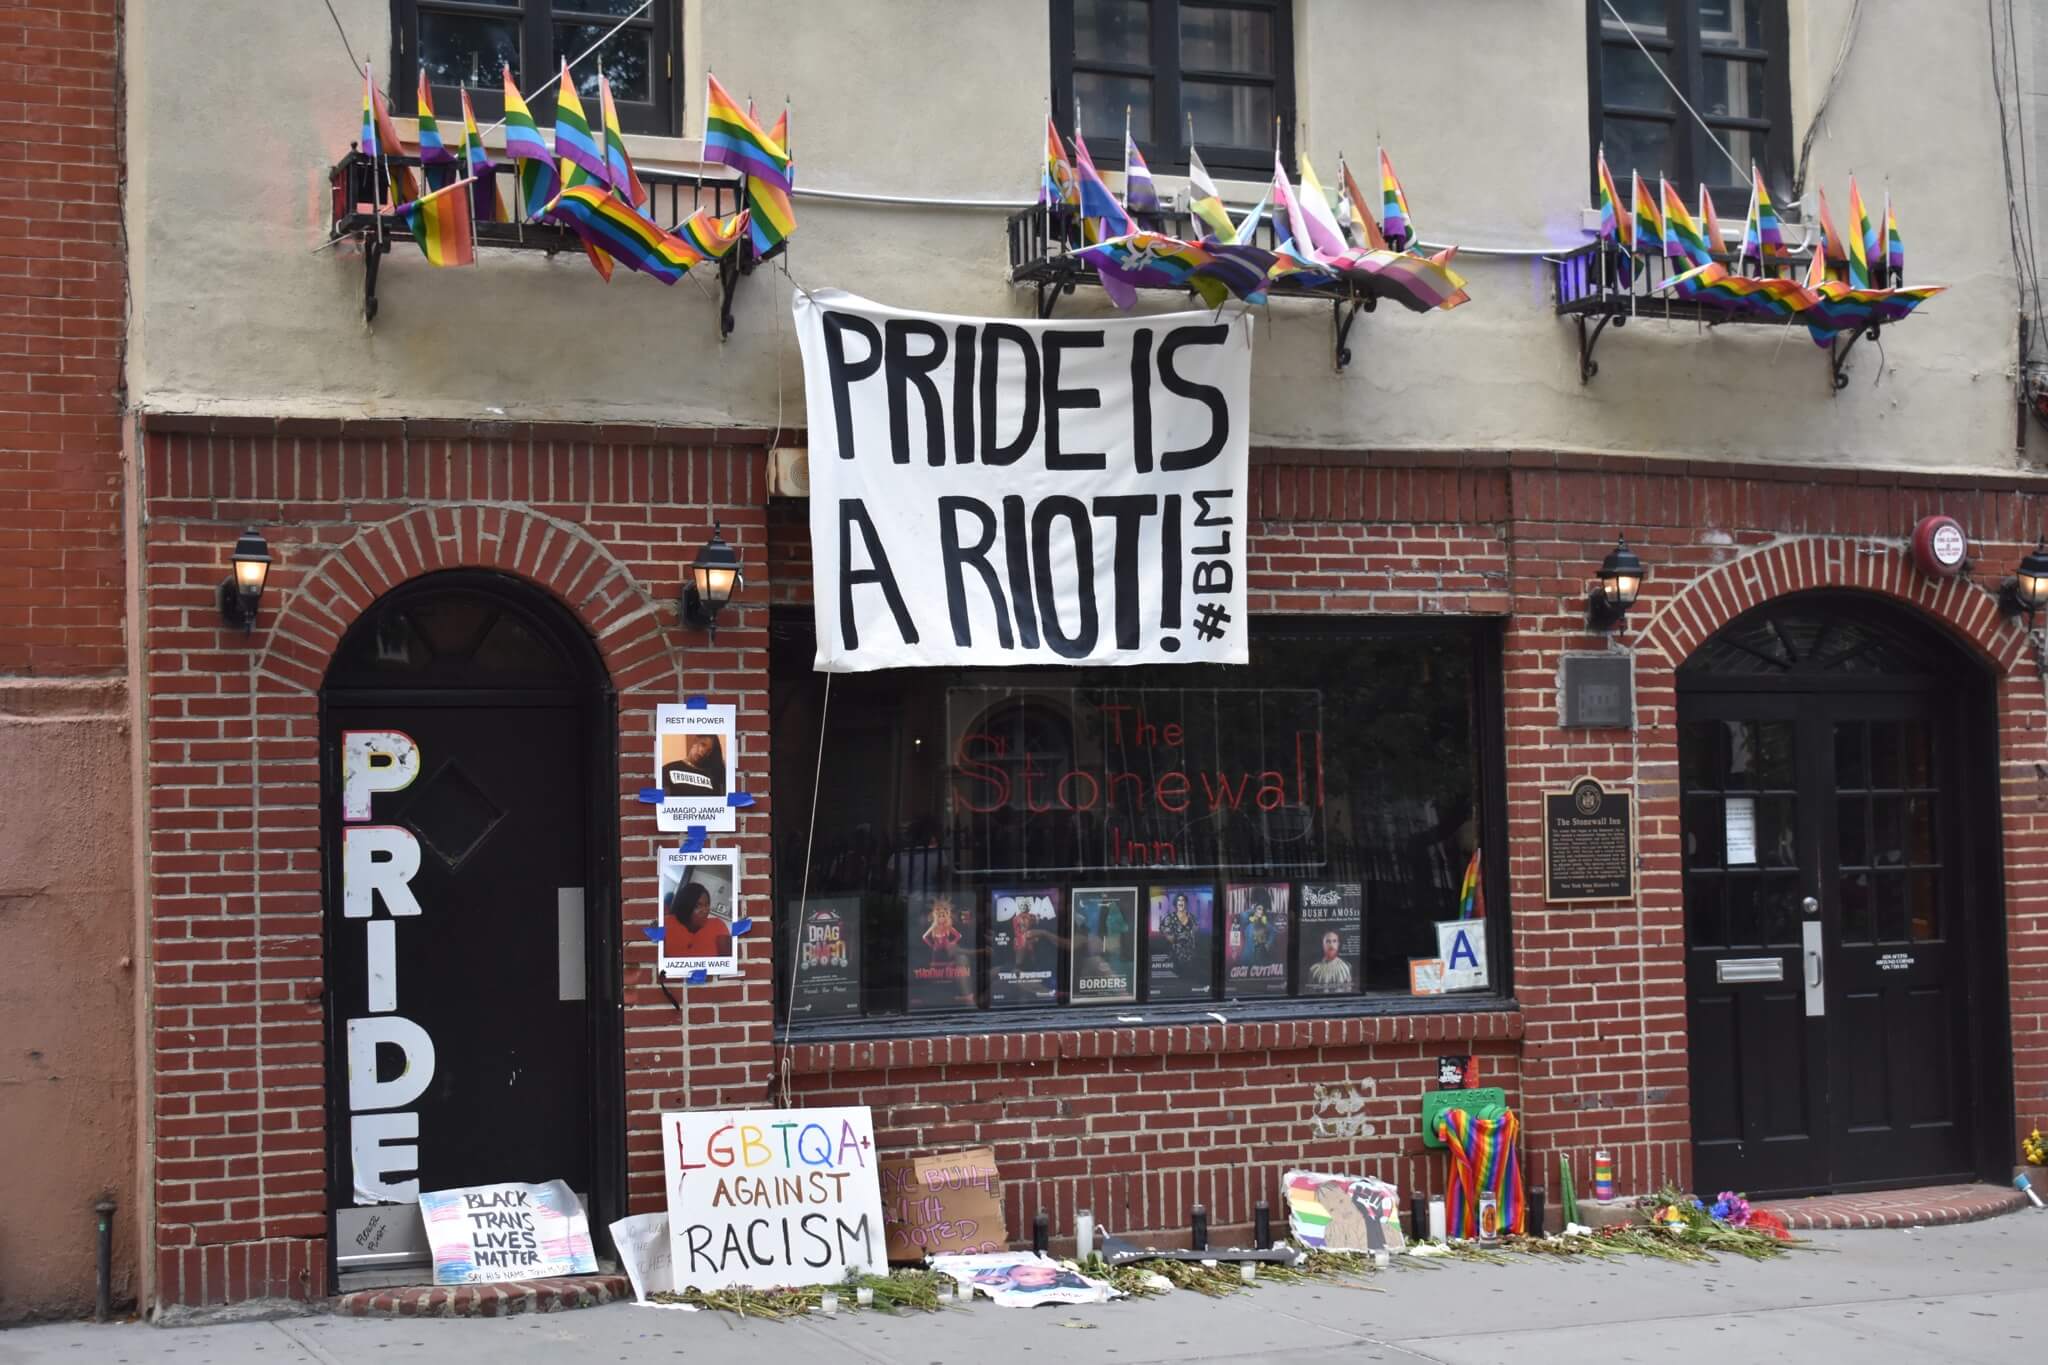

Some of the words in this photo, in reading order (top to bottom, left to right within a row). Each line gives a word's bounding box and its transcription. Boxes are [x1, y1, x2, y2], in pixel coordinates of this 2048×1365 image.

[823, 311, 1106, 471] PRIDE
[1131, 324, 1229, 473] IS
[839, 498, 919, 650] A
[938, 495, 1182, 659] RIOT!
[1099, 704, 1184, 746] The
[954, 730, 1324, 814] Stonewall
[661, 806, 697, 814] JAMAGIO
[698, 806, 725, 814] JAMAR
[672, 813, 716, 821] BERRYMAN
[668, 854, 688, 862] REST
[1115, 826, 1177, 865] Inn
[809, 924, 840, 942] DRAG
[1449, 929, 1478, 970] A
[342, 729, 435, 1206] PRIDE
[1079, 977, 1127, 990] BORDERS
[676, 1119, 871, 1170] LGBTQA+
[712, 1171, 850, 1209] AGAINST
[925, 1165, 995, 1193] BUILT
[464, 1190, 532, 1209] BLACK
[467, 1211, 535, 1232] TRANS
[473, 1231, 537, 1249] LIVES
[680, 1213, 873, 1274] RACISM
[475, 1250, 542, 1268] MATTER
